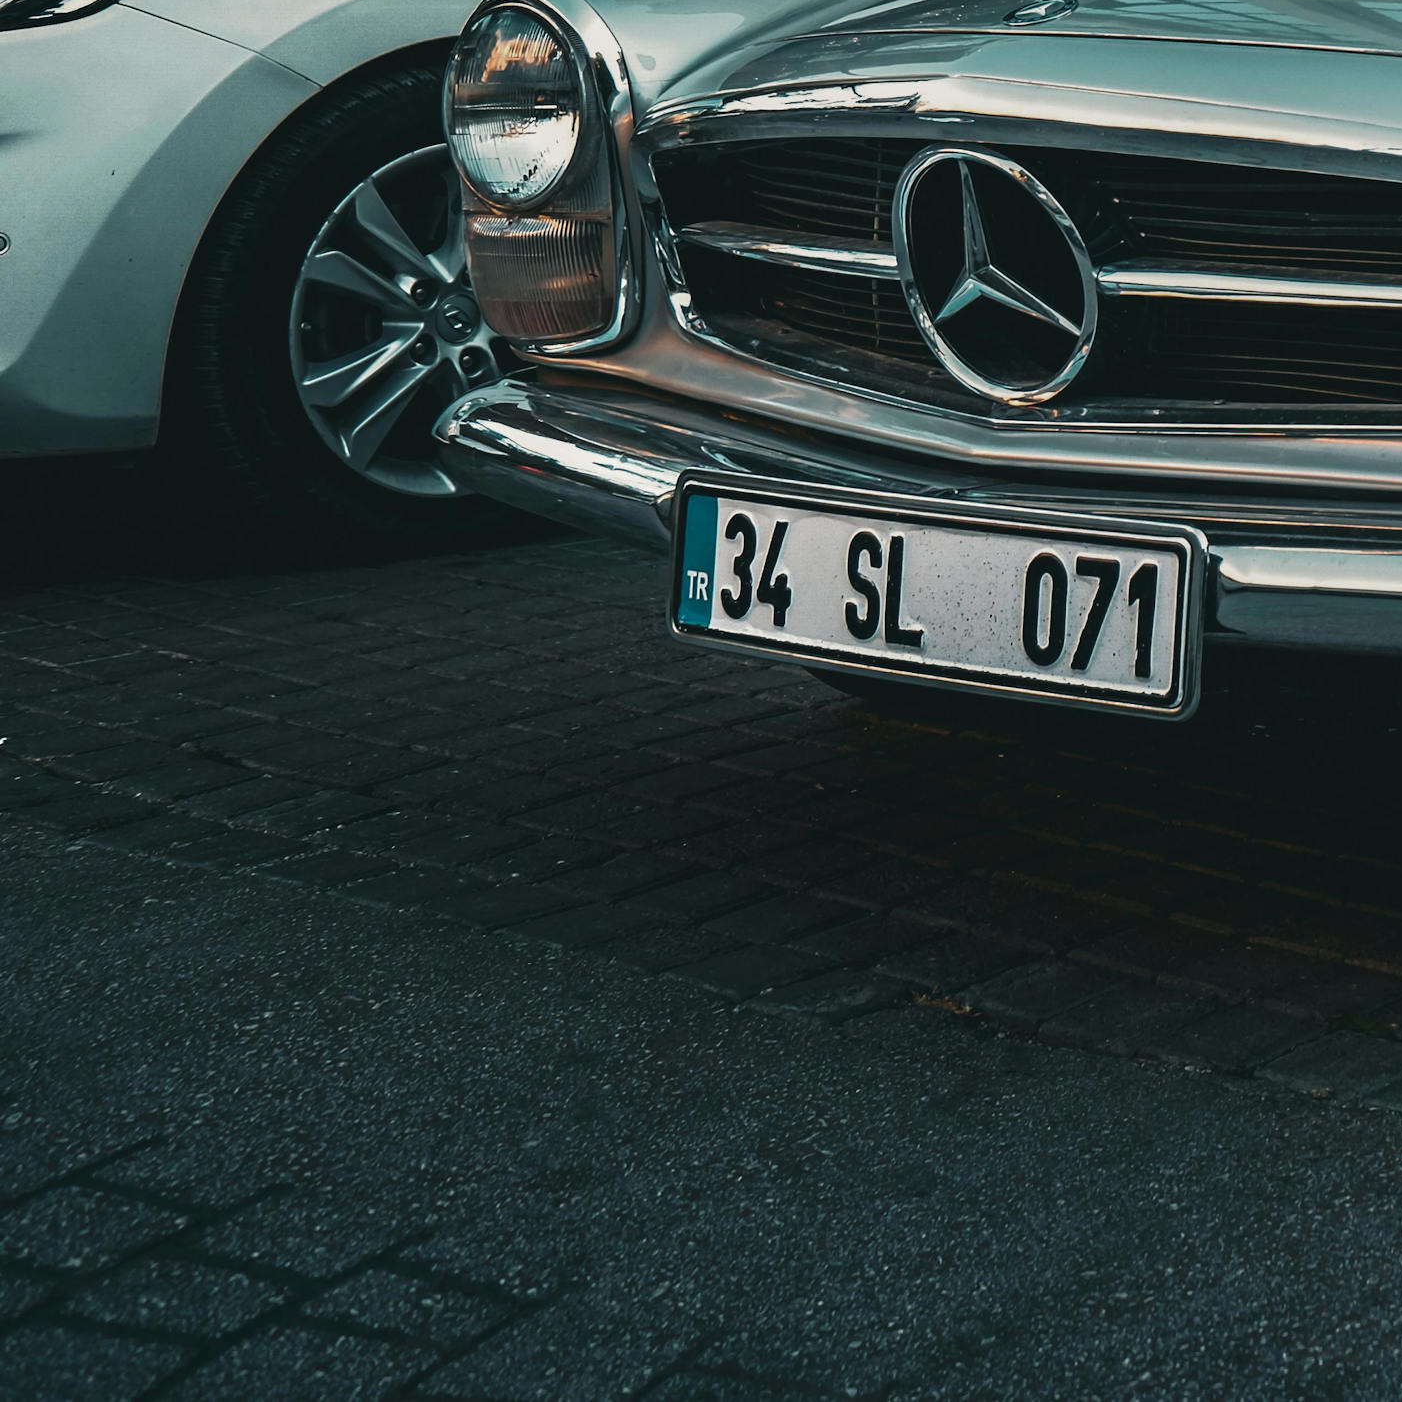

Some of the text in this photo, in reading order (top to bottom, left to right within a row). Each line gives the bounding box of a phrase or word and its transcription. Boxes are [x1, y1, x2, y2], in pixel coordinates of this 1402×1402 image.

[687, 570, 708, 601] TR
[720, 513, 1158, 678] 34 SL 071
